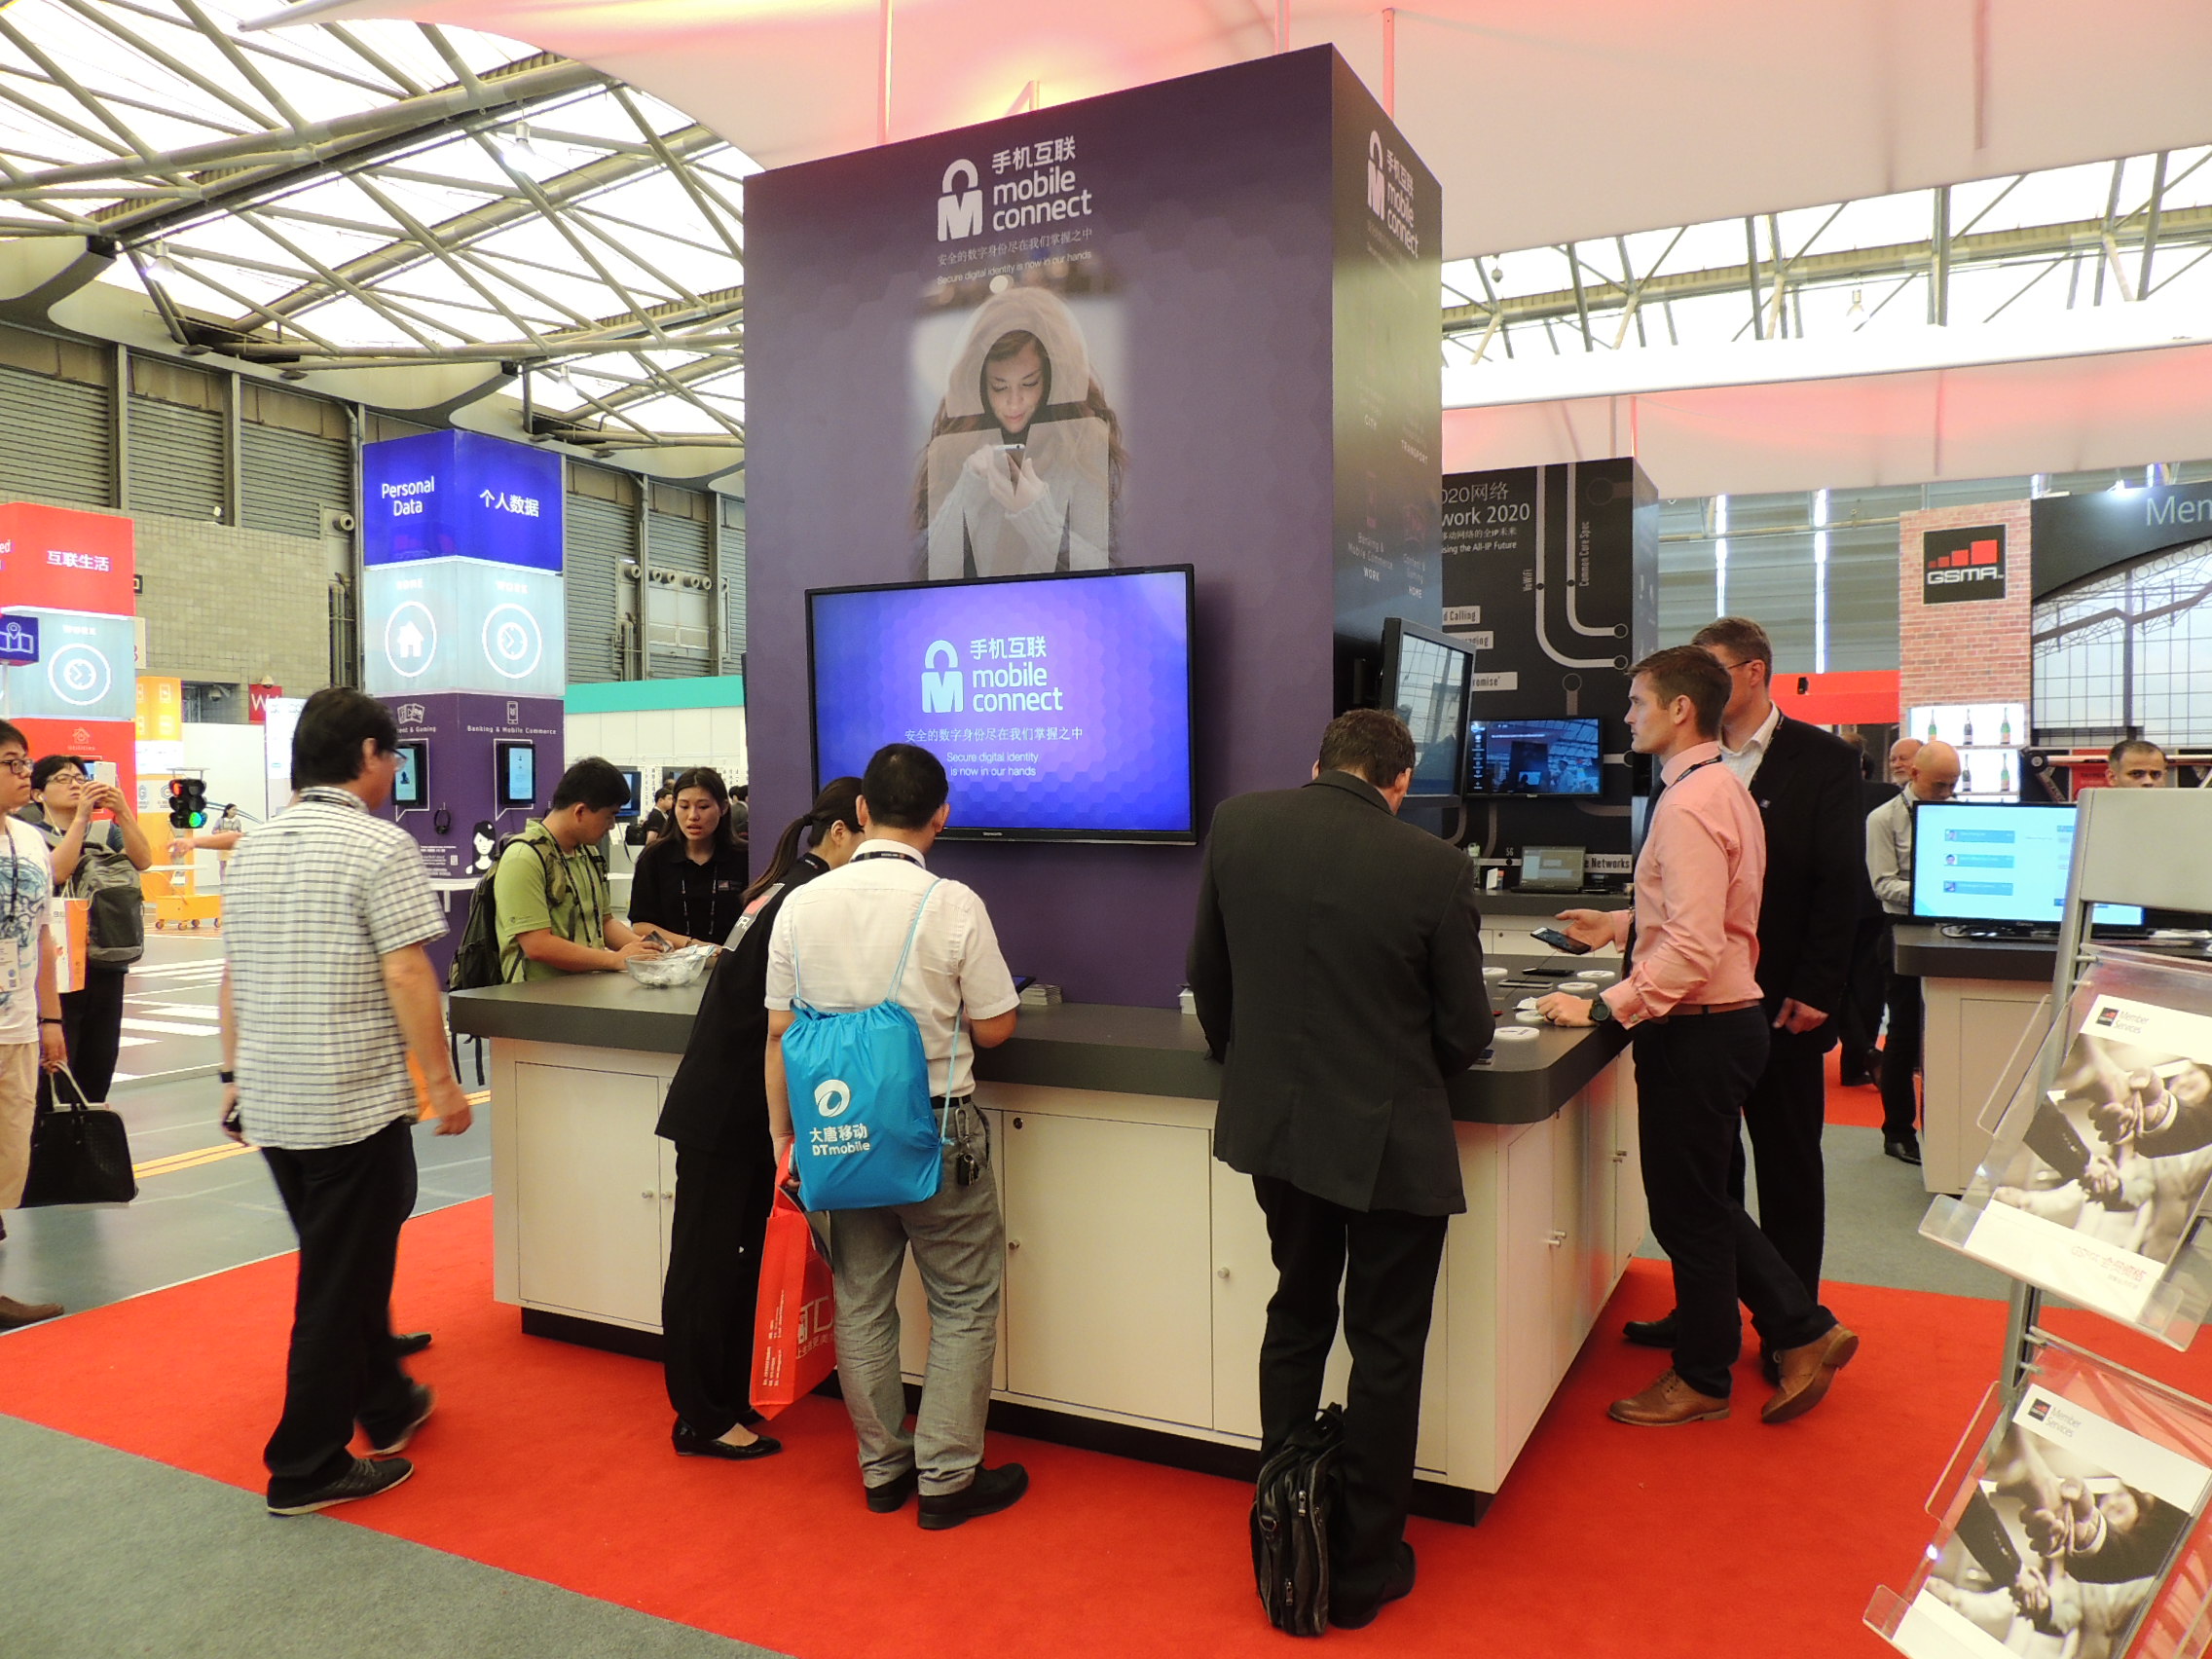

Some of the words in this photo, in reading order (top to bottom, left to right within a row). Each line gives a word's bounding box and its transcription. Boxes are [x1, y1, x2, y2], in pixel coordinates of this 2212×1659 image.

[992, 135, 1076, 174] 手机互联
[993, 166, 1076, 206] mobile
[992, 189, 1092, 232] connect
[1387, 182, 1415, 228] mobile
[1386, 208, 1419, 260] connect
[938, 227, 1092, 267] 安全的数字身份尽在我们掌握之中
[937, 275, 963, 285] Secure
[965, 268, 987, 280] digital
[987, 263, 1015, 275] identity
[1024, 260, 1042, 269] now
[1052, 255, 1065, 265] our
[1067, 250, 1091, 262] hands
[381, 475, 435, 498] Personal
[392, 498, 424, 517] Data
[479, 489, 540, 518] 个人数据
[1487, 502, 1530, 524] 2020
[1578, 521, 1592, 539] Spec
[1459, 543, 1471, 553] the
[1493, 540, 1517, 550] Future
[1578, 539, 1590, 557] Core
[46, 550, 110, 572] 互联生活
[1578, 557, 1590, 587] Common
[1363, 567, 1380, 582] WORK
[1927, 567, 2000, 584] GSMA
[1450, 610, 1476, 623] Calling
[970, 636, 1047, 660] 手机互联
[973, 661, 1048, 688] mobile
[973, 686, 1064, 713] connect
[467, 724, 493, 733] Banking
[525, 726, 557, 735] Commerce
[904, 726, 1084, 743] 安全的数字身份尽在我们掌握之中
[946, 752, 977, 762] Secure
[978, 752, 1005, 763] digital
[1007, 752, 1039, 763] identity
[950, 766, 958, 776] is
[959, 767, 978, 776] now
[980, 766, 989, 776] in
[991, 767, 1007, 776] our
[1008, 766, 1037, 776] hands
[1591, 858, 1631, 869] Networks
[809, 1123, 868, 1143] 大唐移动
[812, 1141, 870, 1157] DTmobile
